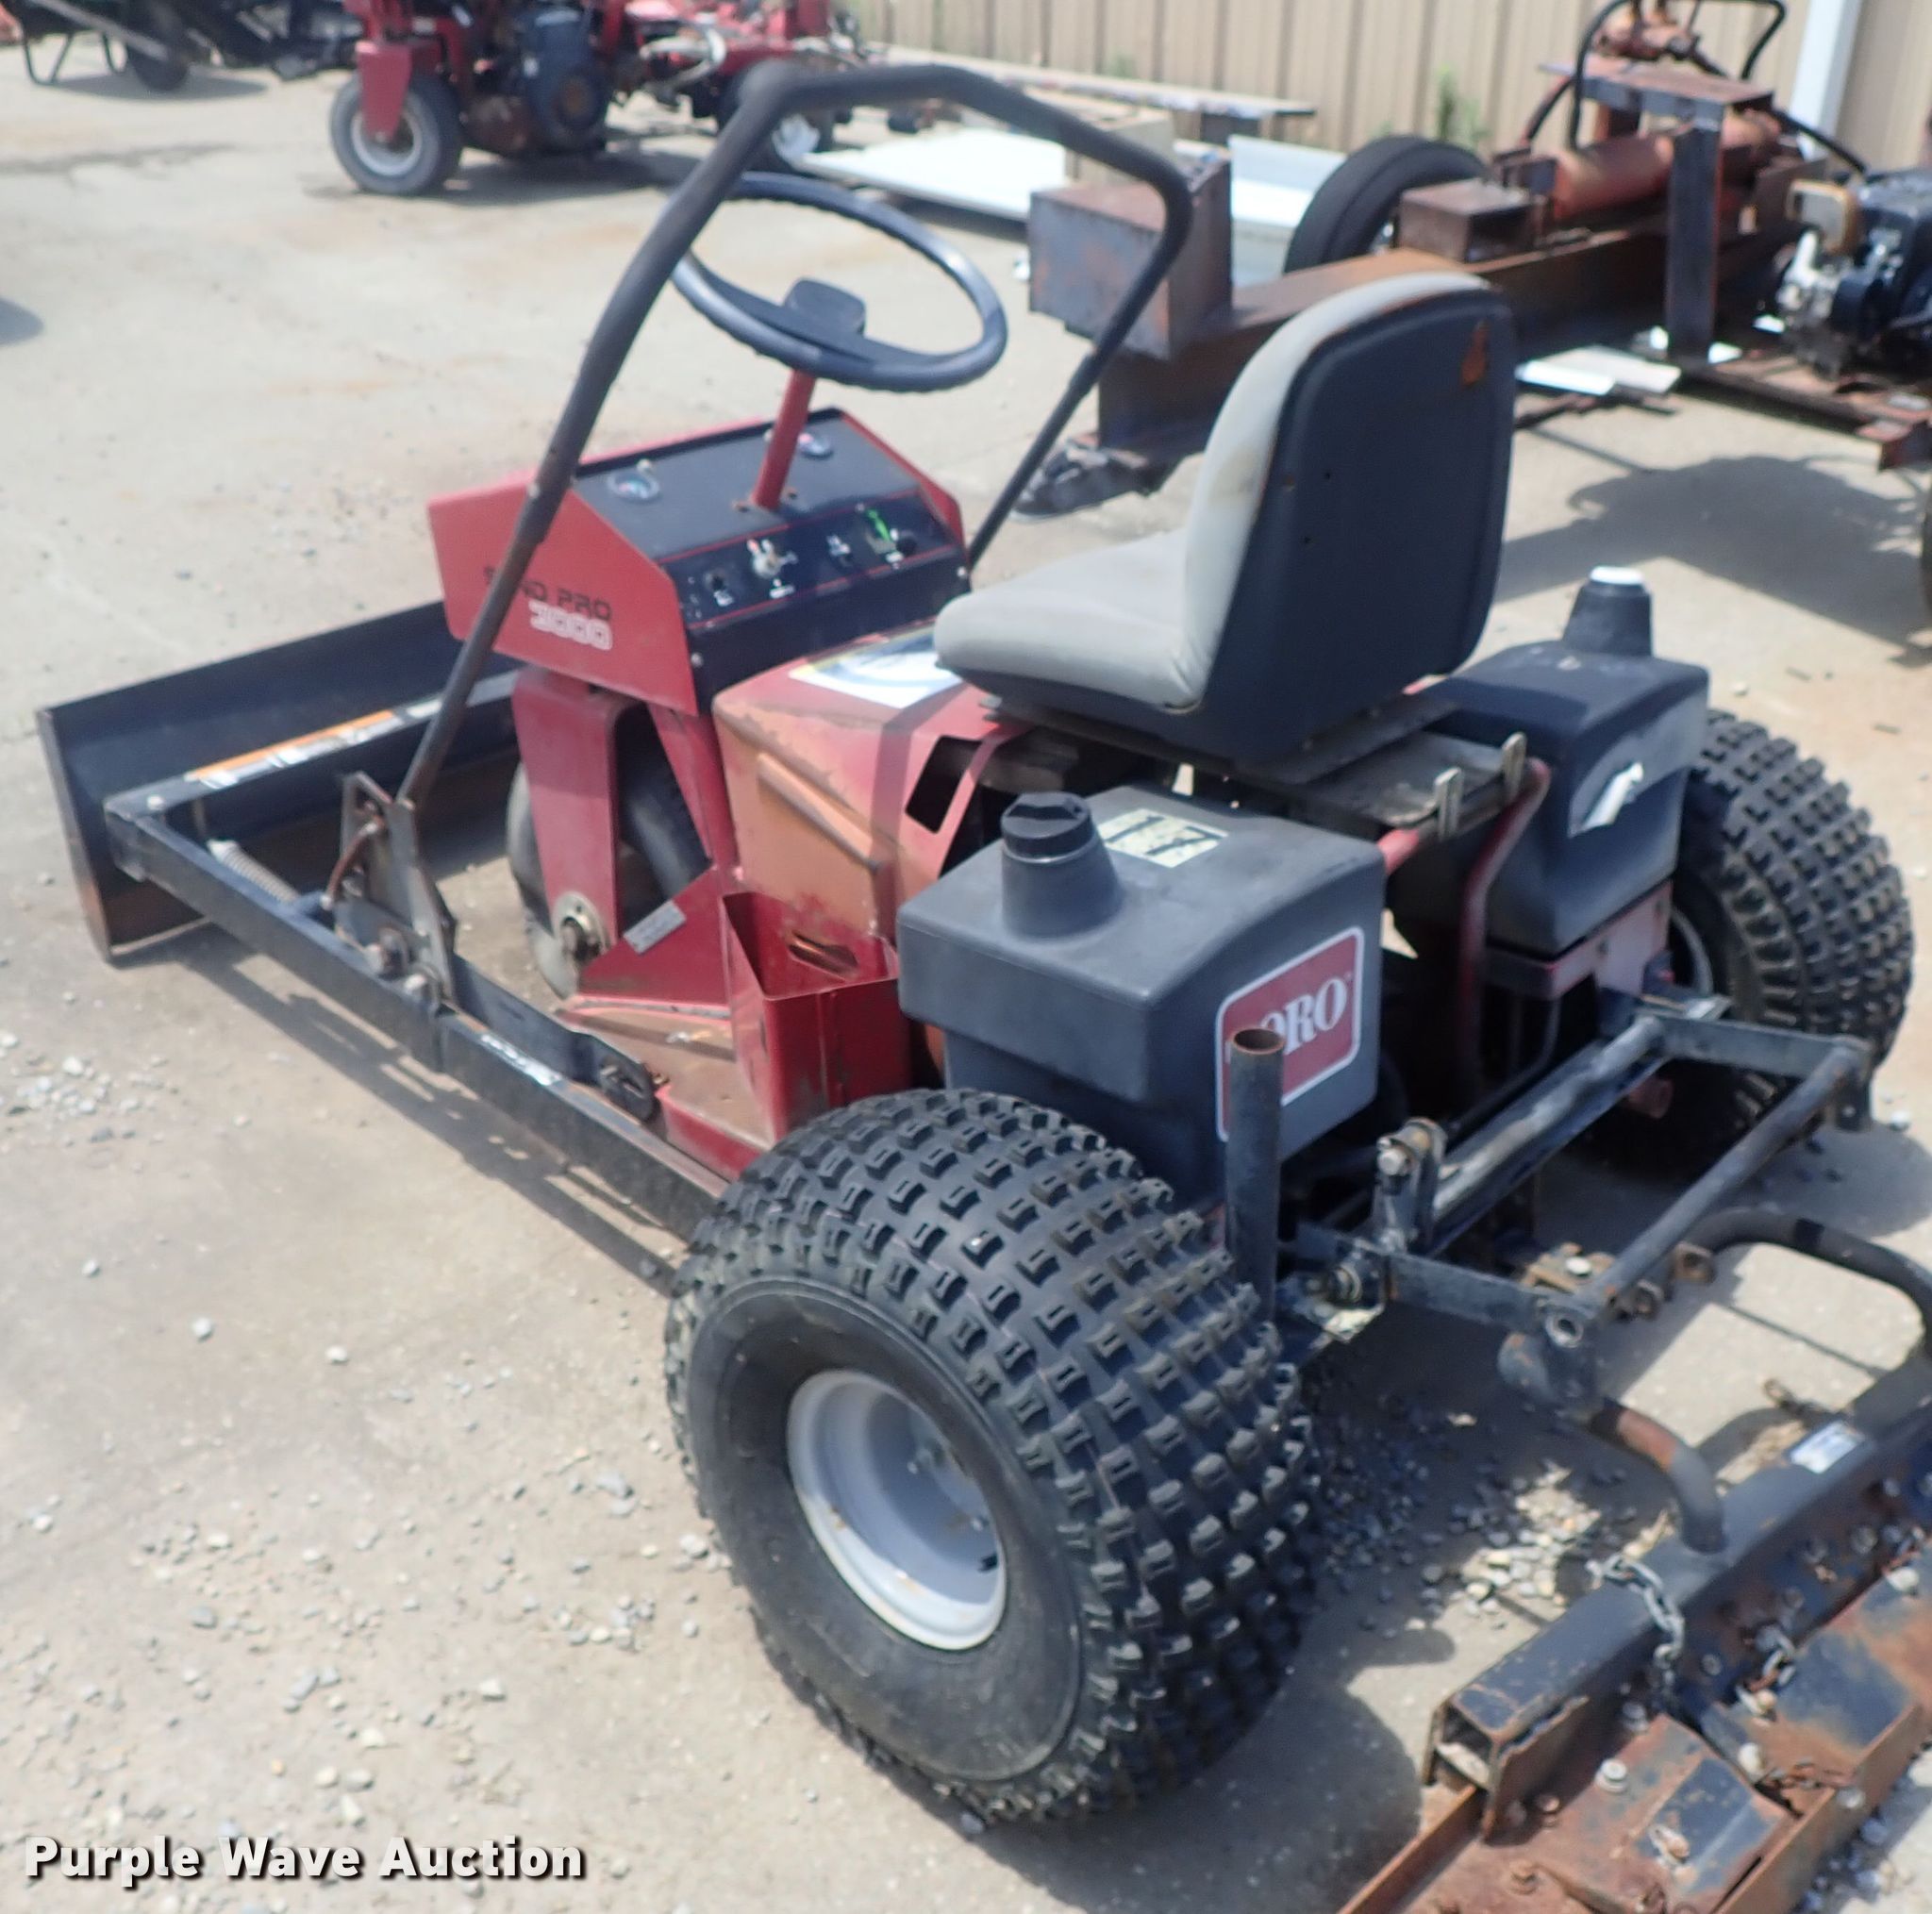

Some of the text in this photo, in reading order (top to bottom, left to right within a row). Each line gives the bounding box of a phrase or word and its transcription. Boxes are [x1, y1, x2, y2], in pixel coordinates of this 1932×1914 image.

[483, 566, 611, 621] SD PRO
[1104, 815, 1224, 857] 17
